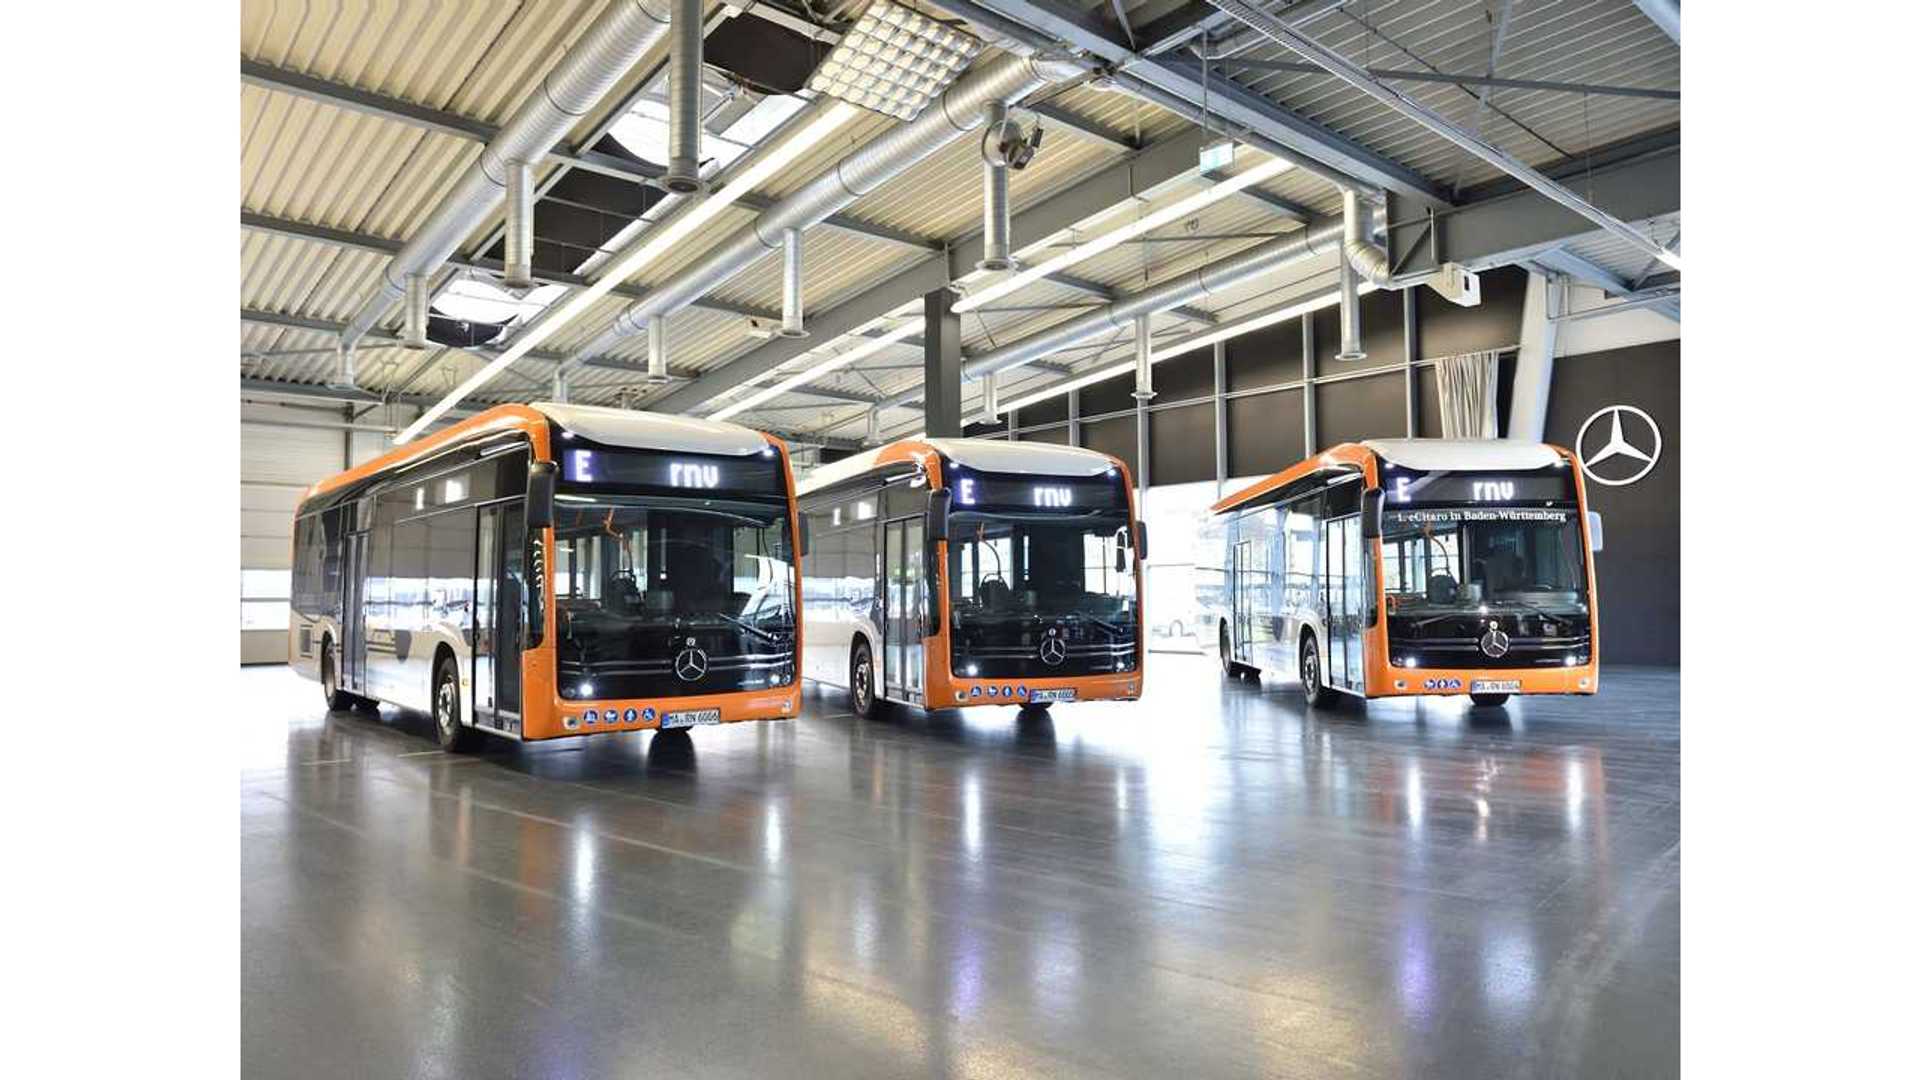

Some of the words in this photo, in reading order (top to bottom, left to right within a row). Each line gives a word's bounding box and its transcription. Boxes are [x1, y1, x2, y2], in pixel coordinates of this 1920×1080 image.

[575, 450, 593, 482] E
[960, 478, 976, 505] E
[1396, 477, 1411, 502] E
[1408, 511, 1448, 522] eCitaro
[1465, 510, 1567, 522] Baden-Württemberg
